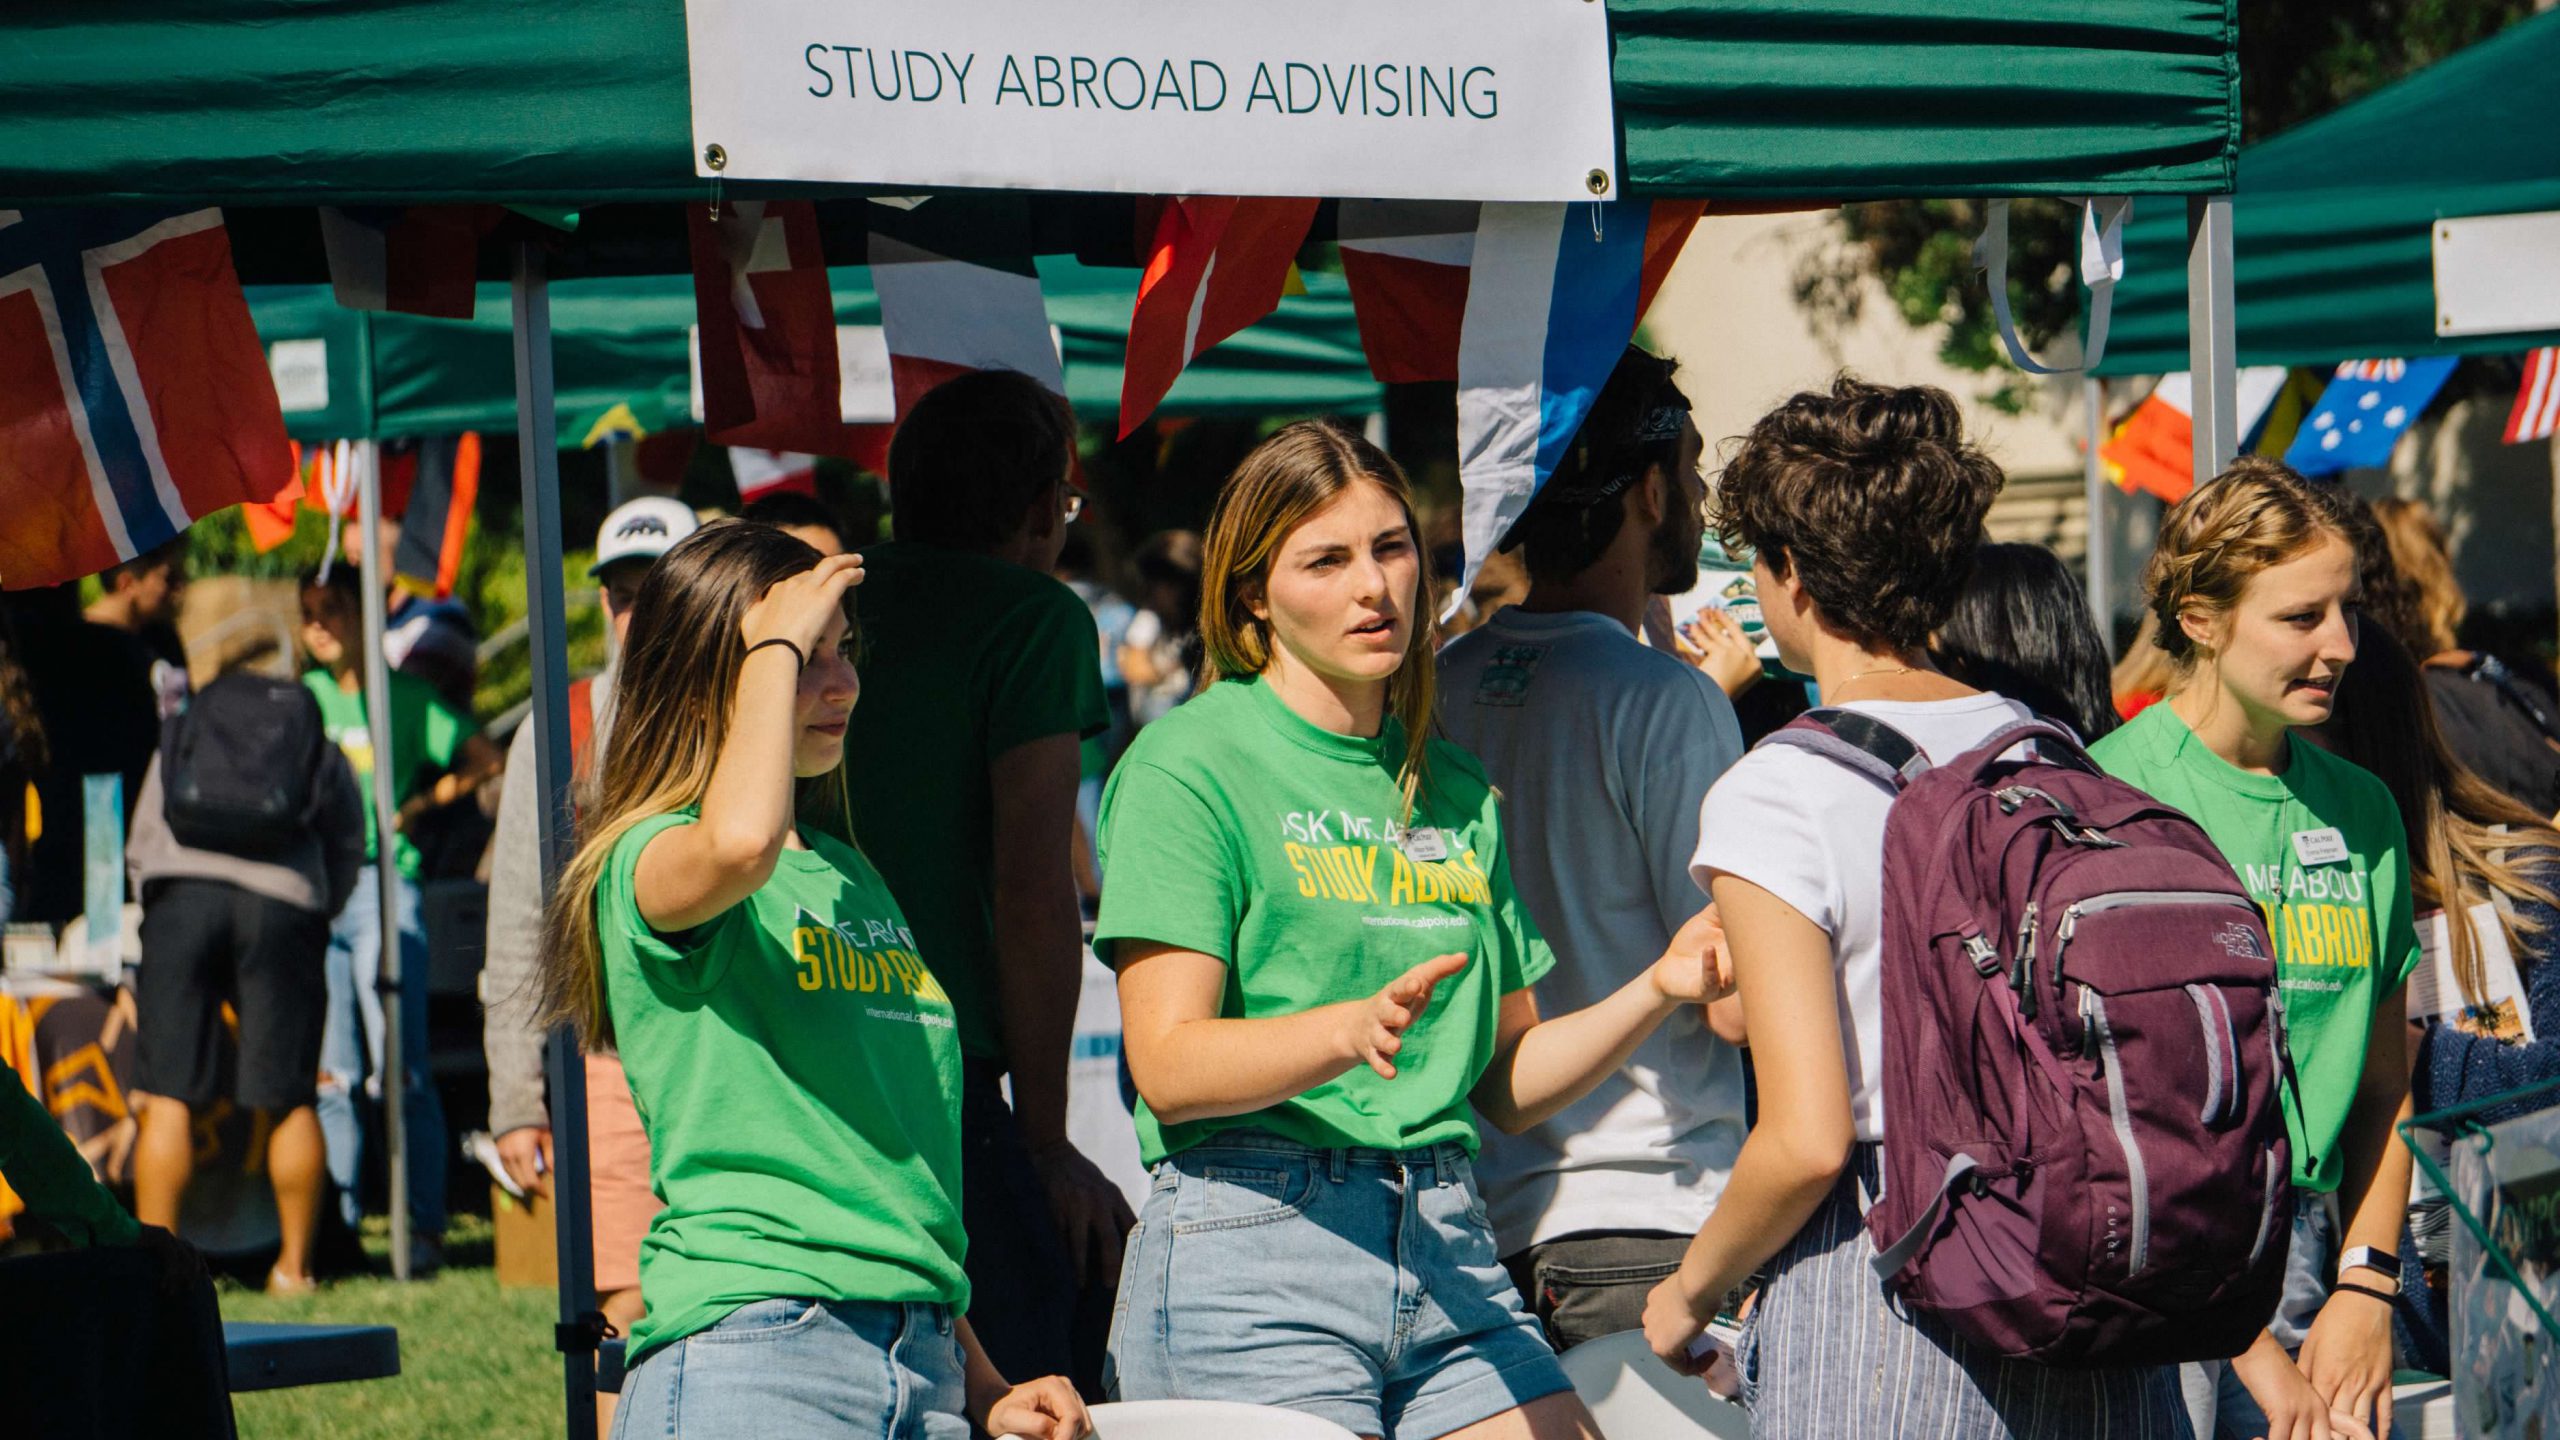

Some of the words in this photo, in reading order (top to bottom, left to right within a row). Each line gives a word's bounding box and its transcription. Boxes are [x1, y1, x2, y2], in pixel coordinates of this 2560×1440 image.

[804, 43, 975, 105] STUDY
[995, 54, 1228, 112] ABROAD
[1246, 62, 1498, 120] ADVISING
[1284, 842, 1379, 904] STUDY
[1390, 847, 1493, 906] ABROA
[2282, 903, 2373, 968] ABROA
